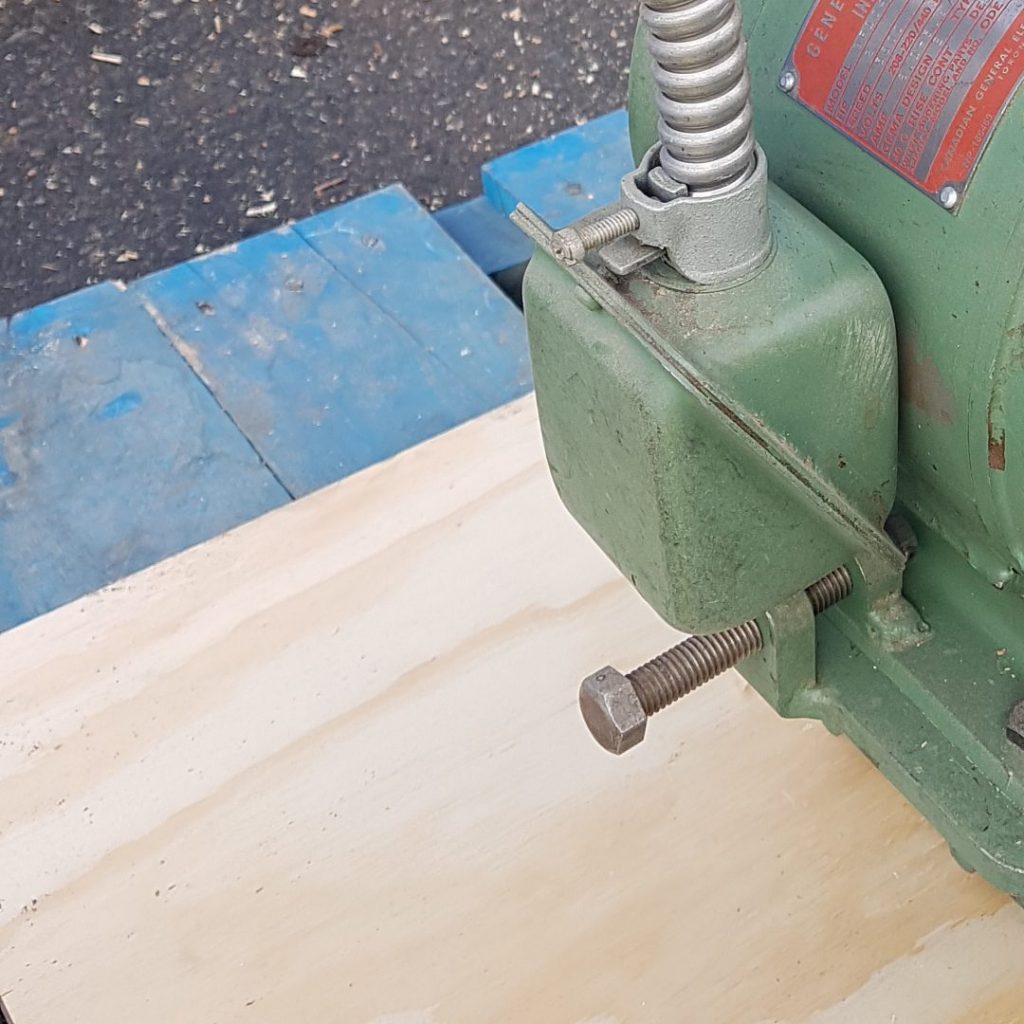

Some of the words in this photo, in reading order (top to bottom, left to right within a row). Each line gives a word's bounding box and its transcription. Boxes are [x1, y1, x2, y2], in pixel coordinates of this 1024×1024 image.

[978, 2, 1003, 30] ODE
[899, 54, 934, 108] DESIGN
[906, 92, 928, 126] RISE
[926, 46, 954, 86] CONT
[968, 1, 986, 20] DE
[973, 46, 1014, 101] GENERAL
